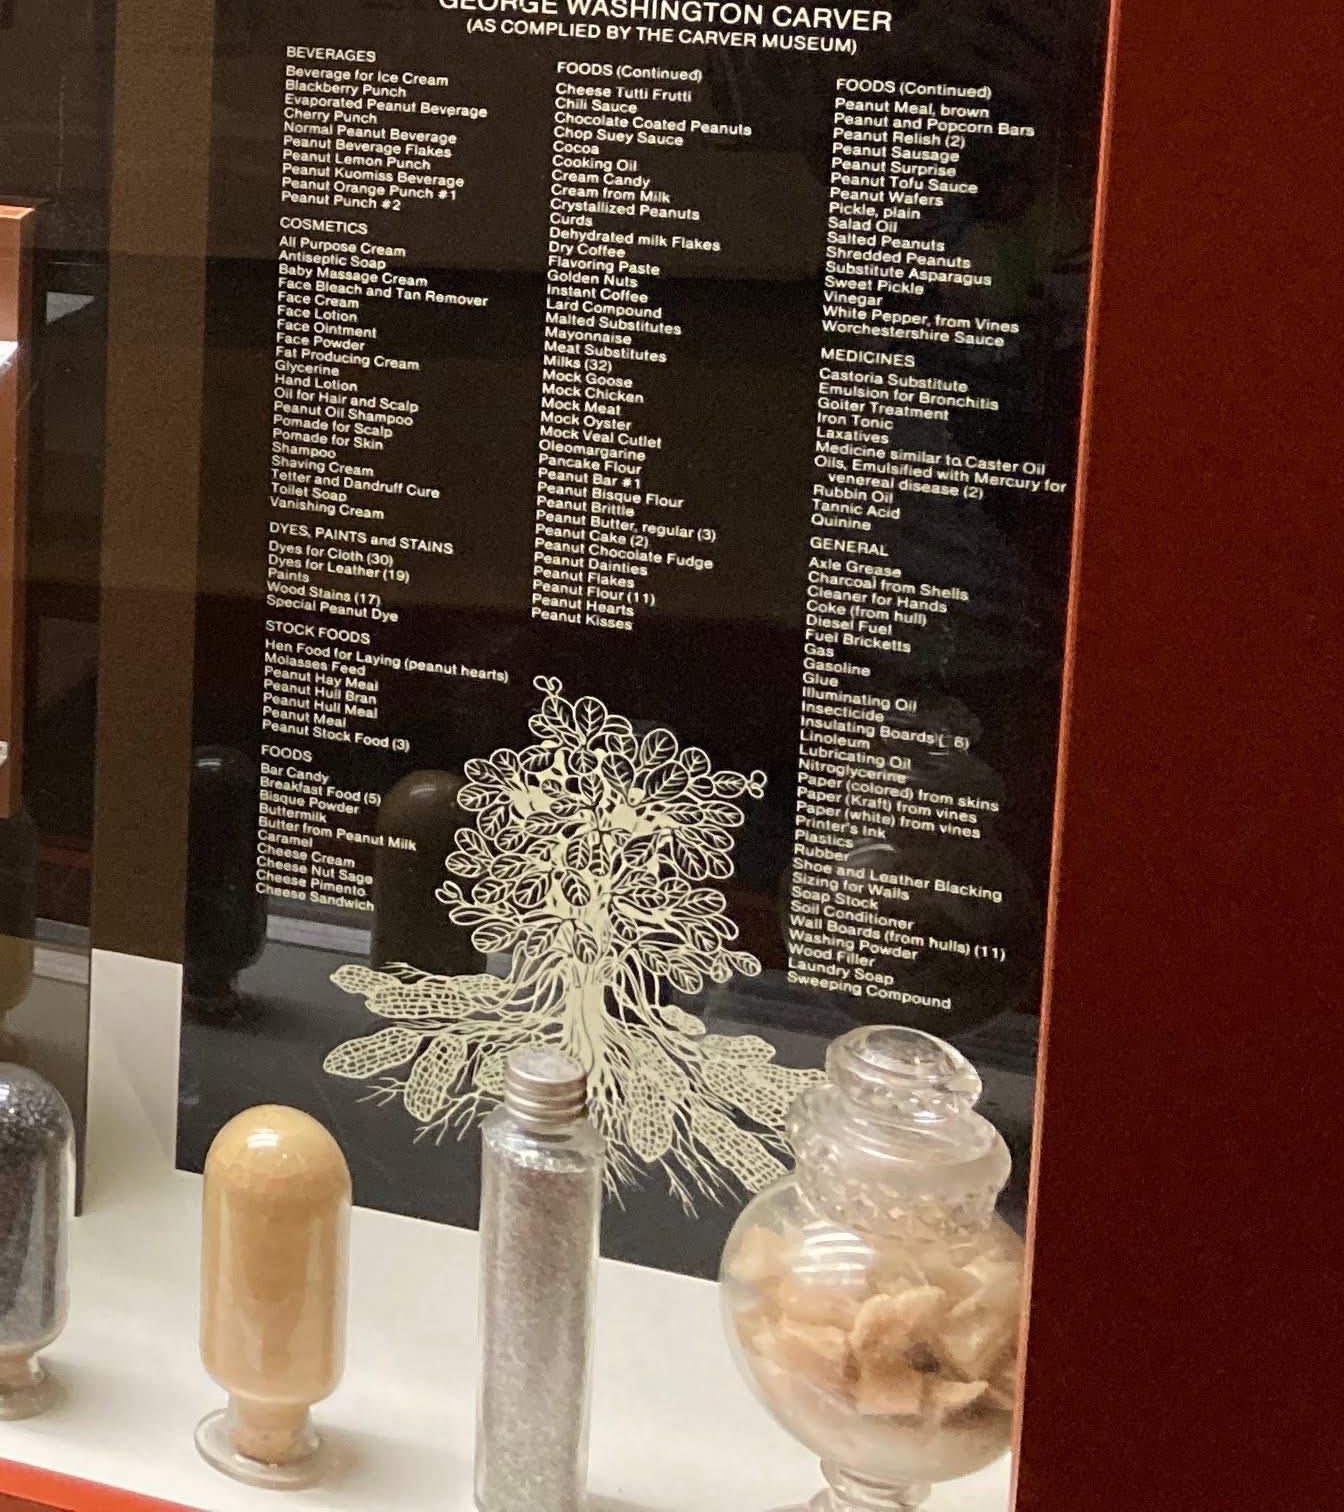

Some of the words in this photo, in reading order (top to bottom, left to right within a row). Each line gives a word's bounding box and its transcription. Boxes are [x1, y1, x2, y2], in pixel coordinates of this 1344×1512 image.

[772, 5, 892, 31] CARVER
[467, 19, 496, 35] (AS
[501, 19, 601, 38] COMPLIED
[607, 25, 631, 40] BY
[636, 27, 674, 43] THE
[679, 29, 756, 47] CARVER
[762, 34, 857, 55] MUSEUM)
[287, 46, 376, 62] BEVERAGES
[286, 66, 351, 81] Beverage
[355, 69, 374, 81] for
[378, 71, 398, 83] Ice
[402, 72, 448, 86] Cream
[558, 62, 613, 76] FOODS
[616, 65, 702, 83] (Continued)
[556, 83, 611, 97] Cheese
[616, 87, 648, 99] Tutti
[653, 89, 691, 102] Frutti
[837, 78, 895, 93] FOODS
[900, 82, 992, 100] (Continued)
[285, 94, 362, 109] Evaporated
[367, 99, 416, 112] Peanut
[421, 102, 487, 119] Beverage
[834, 114, 888, 127] Peanut
[893, 118, 922, 129] and
[927, 119, 993, 133] Popcorn
[998, 123, 1034, 136] Bars
[553, 157, 612, 172] Cooking
[617, 159, 637, 171] Oil
[831, 173, 885, 187] Peanut
[889, 177, 923, 189] Tofu
[928, 179, 978, 193] Sauce
[280, 217, 367, 234] COSMETICS
[279, 237, 296, 248] All
[301, 238, 356, 253] Purpose
[361, 243, 406, 257] Cream
[821, 348, 915, 367] MEDICINES
[820, 370, 883, 384] Castoria
[888, 375, 968, 392] Substitute
[542, 385, 581, 397] Mock
[585, 388, 643, 403] Chicken
[810, 537, 889, 556] GENERAL
[809, 558, 841, 570] Axle
[846, 561, 901, 577] Grease
[532, 608, 581, 623] Peanut
[586, 614, 632, 630] Kisses
[266, 620, 314, 637] STOCK
[319, 627, 370, 644] FOODS
[261, 745, 312, 762] FOODS
